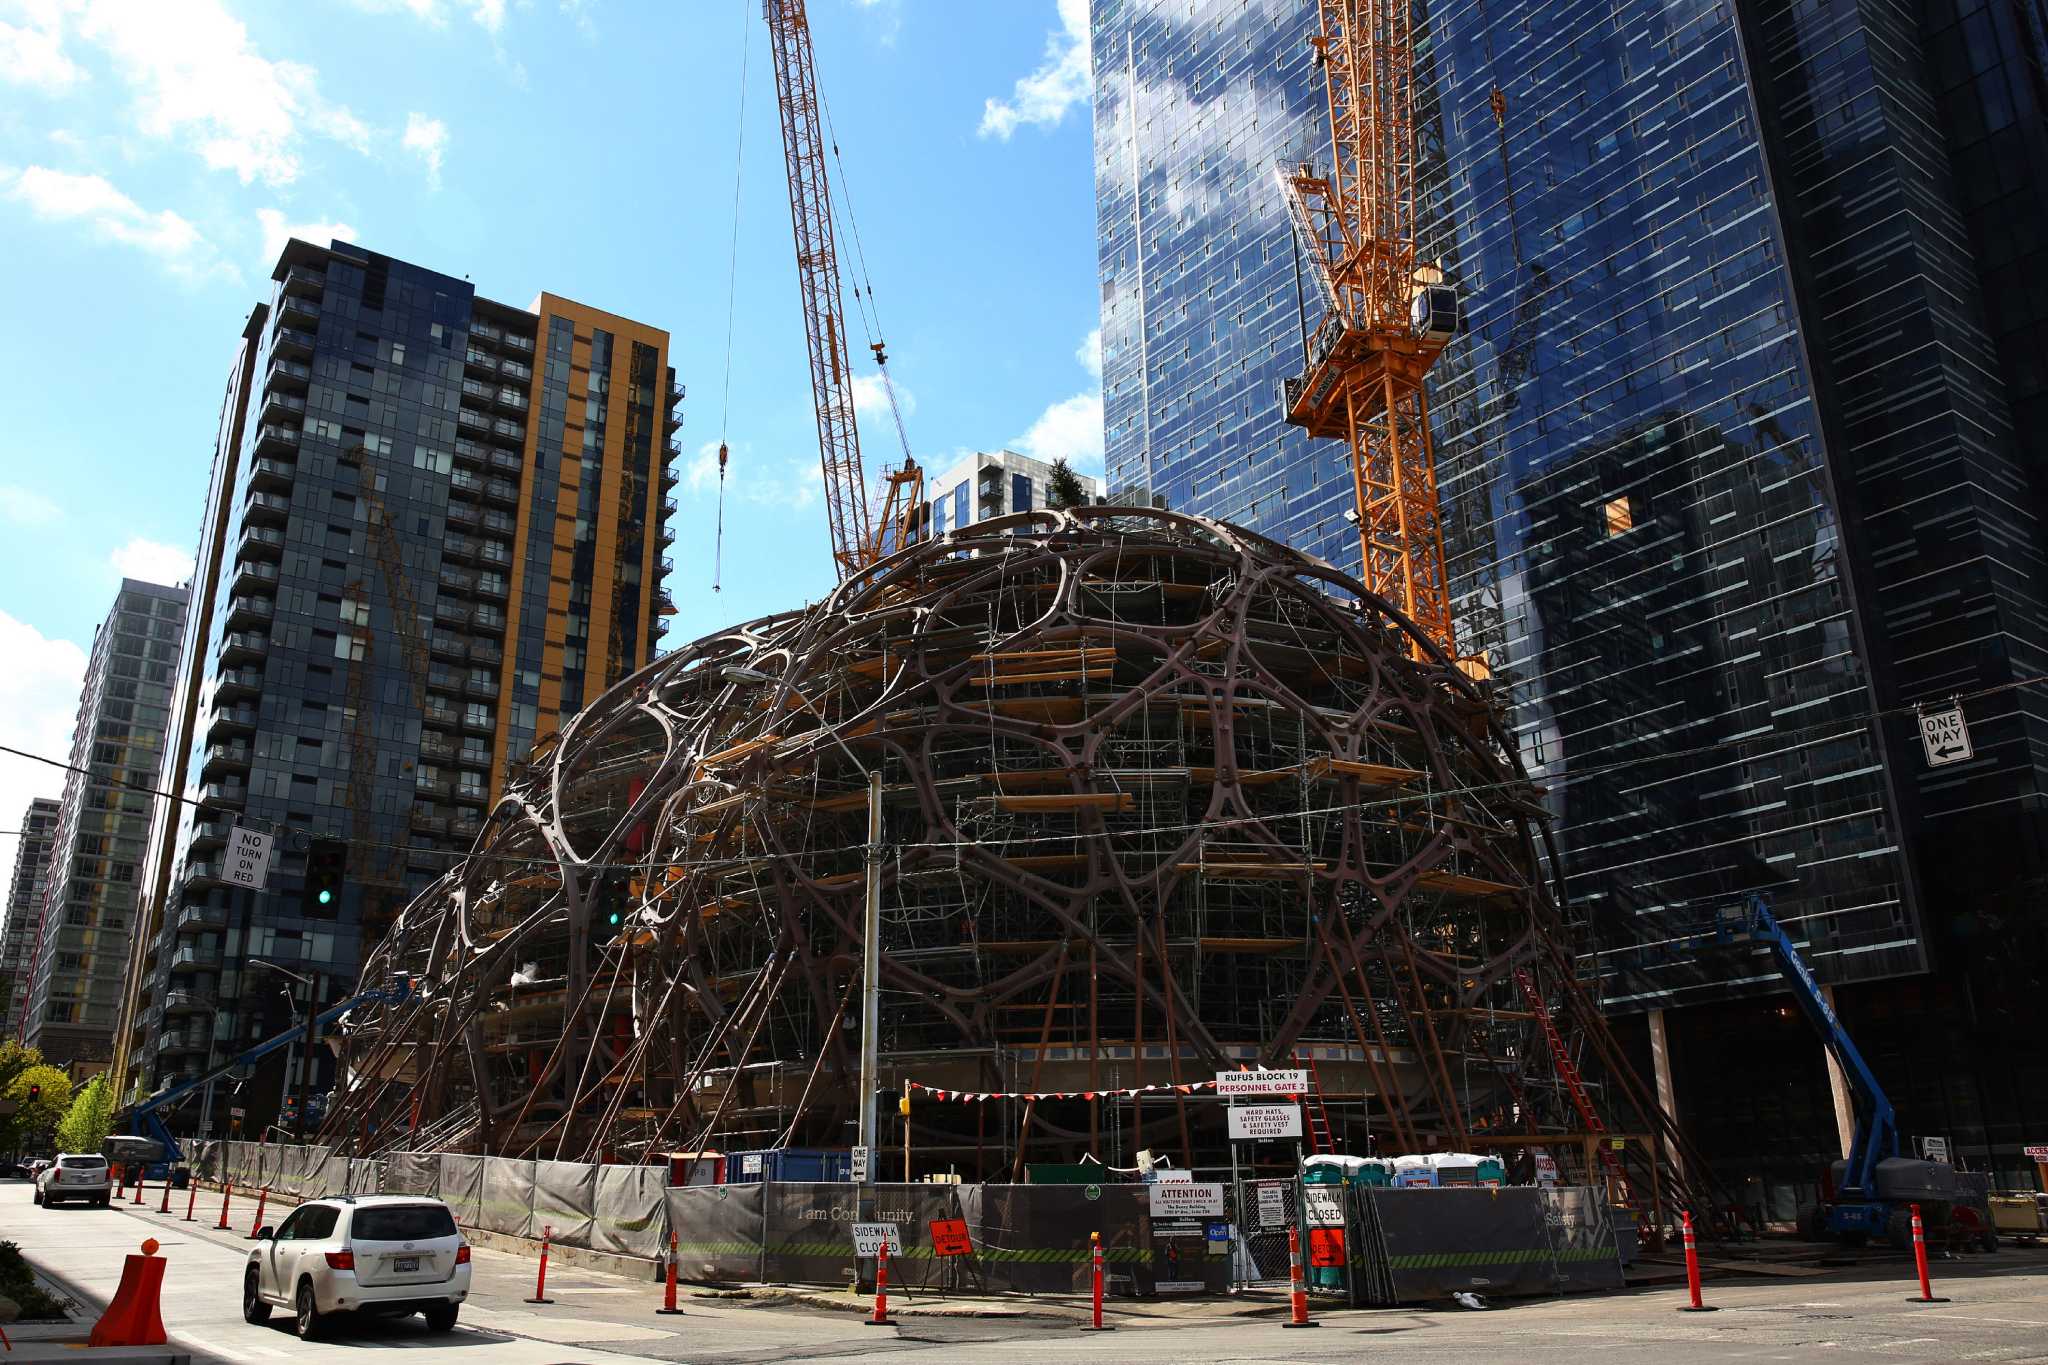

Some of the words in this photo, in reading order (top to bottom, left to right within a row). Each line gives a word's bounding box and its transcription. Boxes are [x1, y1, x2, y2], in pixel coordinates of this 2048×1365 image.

[1926, 715, 1959, 731] ONE
[1928, 728, 1961, 745] WAY
[242, 834, 261, 847] NO
[237, 847, 262, 860] TURN
[240, 860, 253, 870] ON
[234, 871, 253, 882] RED
[1225, 1073, 1254, 1081] RUFUS
[1220, 1084, 1271, 1092] PERSONNEL
[1274, 1083, 1297, 1091] GATE
[1161, 1189, 1212, 1198] ATTENTION
[1305, 1192, 1342, 1203] SIDEWALK
[805, 1209, 828, 1220] am
[1308, 1209, 1341, 1220] CLOSED
[855, 1227, 897, 1237] SIDEWALK
[935, 1233, 967, 1244] DETOUR
